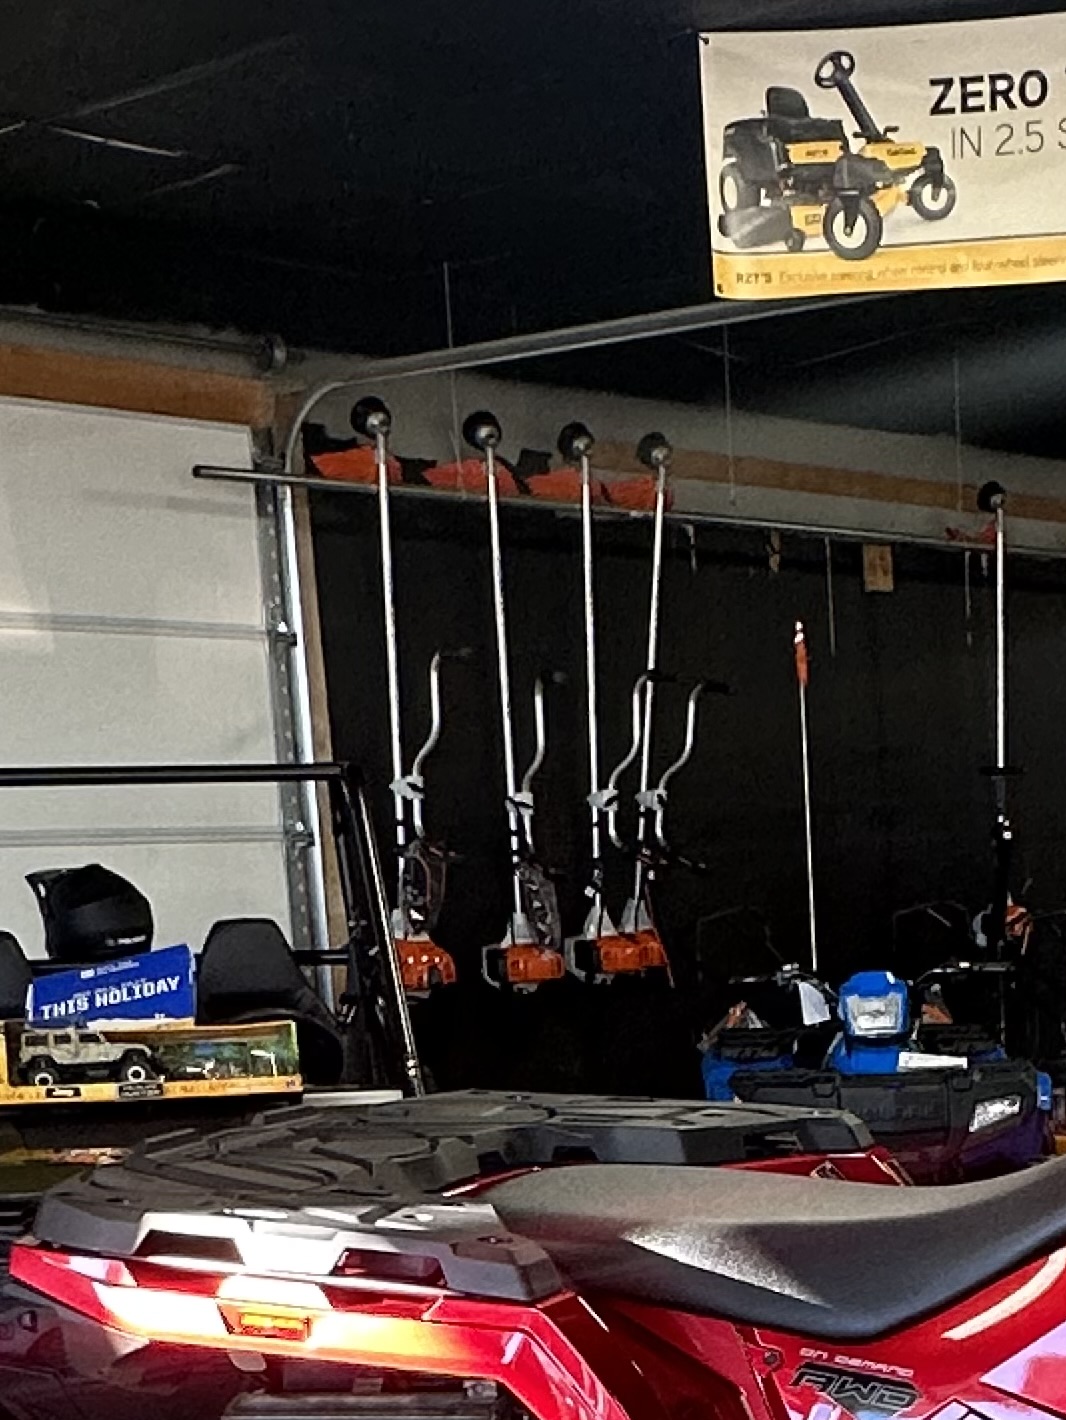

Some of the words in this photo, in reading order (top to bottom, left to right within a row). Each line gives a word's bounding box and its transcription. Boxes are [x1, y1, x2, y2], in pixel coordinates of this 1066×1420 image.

[928, 69, 1048, 116] ZERO
[950, 125, 982, 159] IN
[994, 119, 1044, 156] 2.5
[40, 992, 90, 1020] THIS
[94, 975, 181, 1008] HOLIDAY
